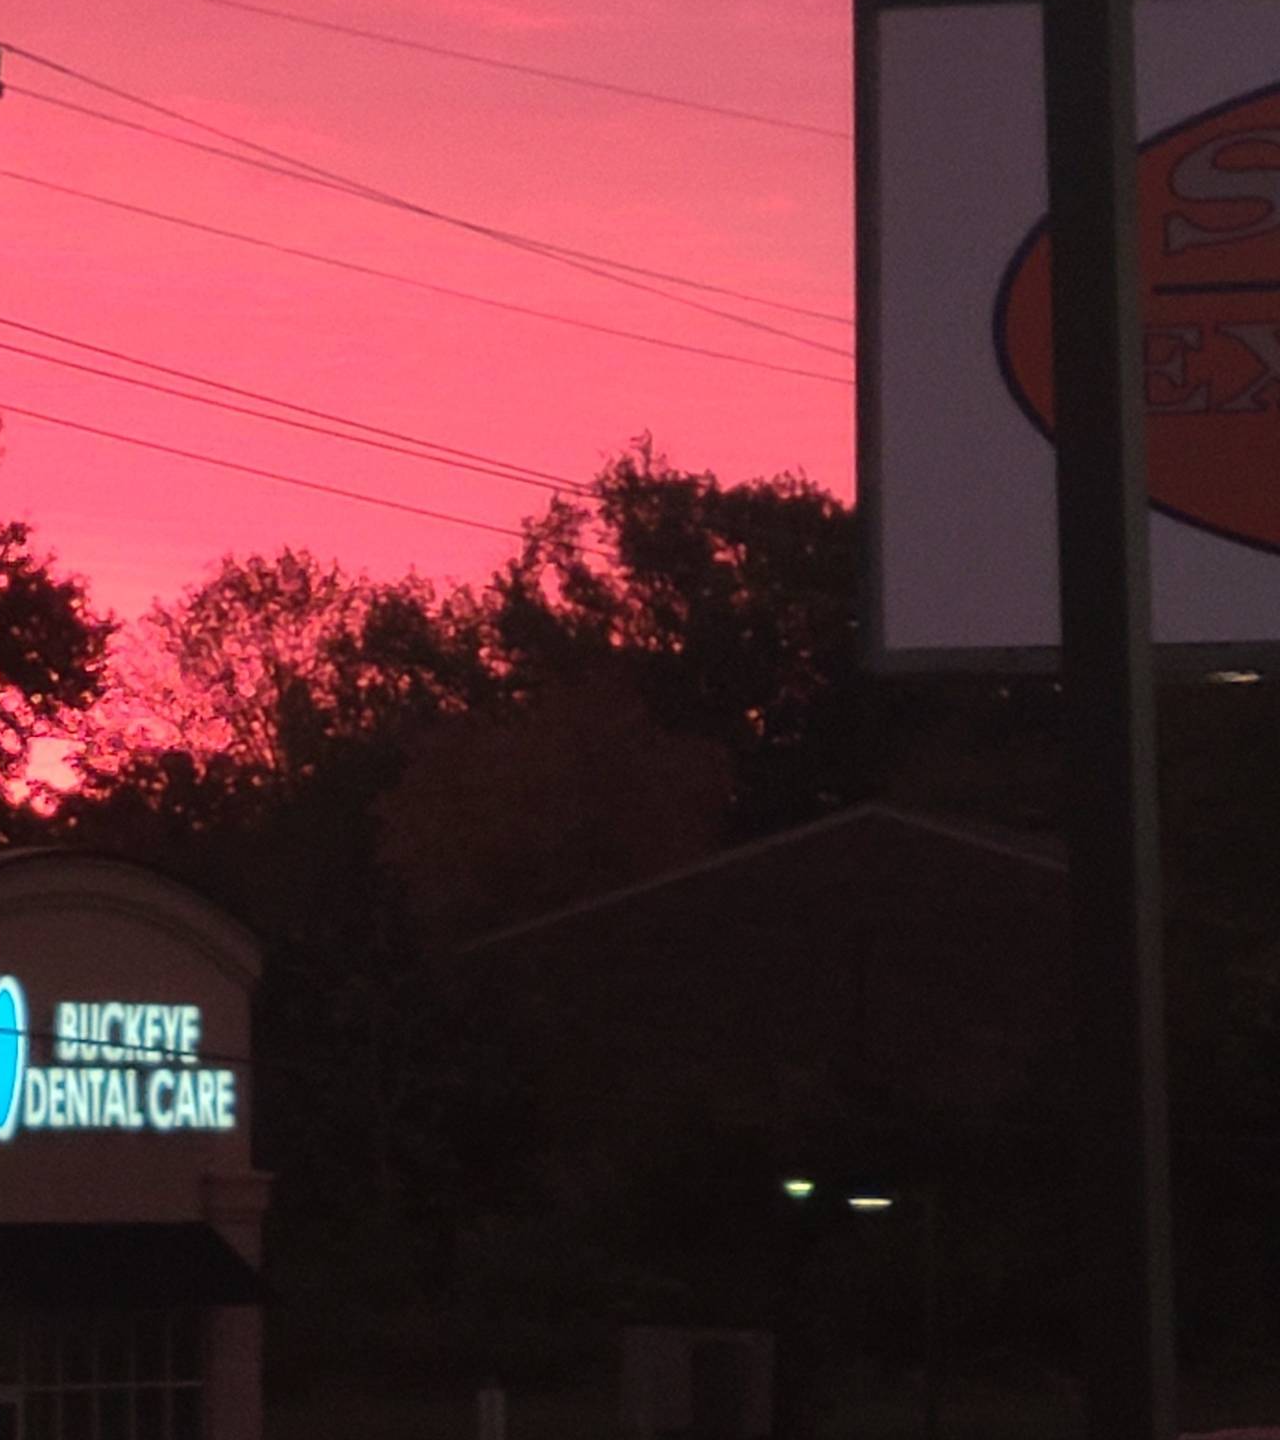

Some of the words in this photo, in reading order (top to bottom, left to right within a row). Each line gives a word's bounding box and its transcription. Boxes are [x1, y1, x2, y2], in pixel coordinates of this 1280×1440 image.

[57, 1001, 200, 1063] BUCKEYE
[24, 1067, 144, 1128] DENTAL
[148, 1068, 236, 1130] CARE
